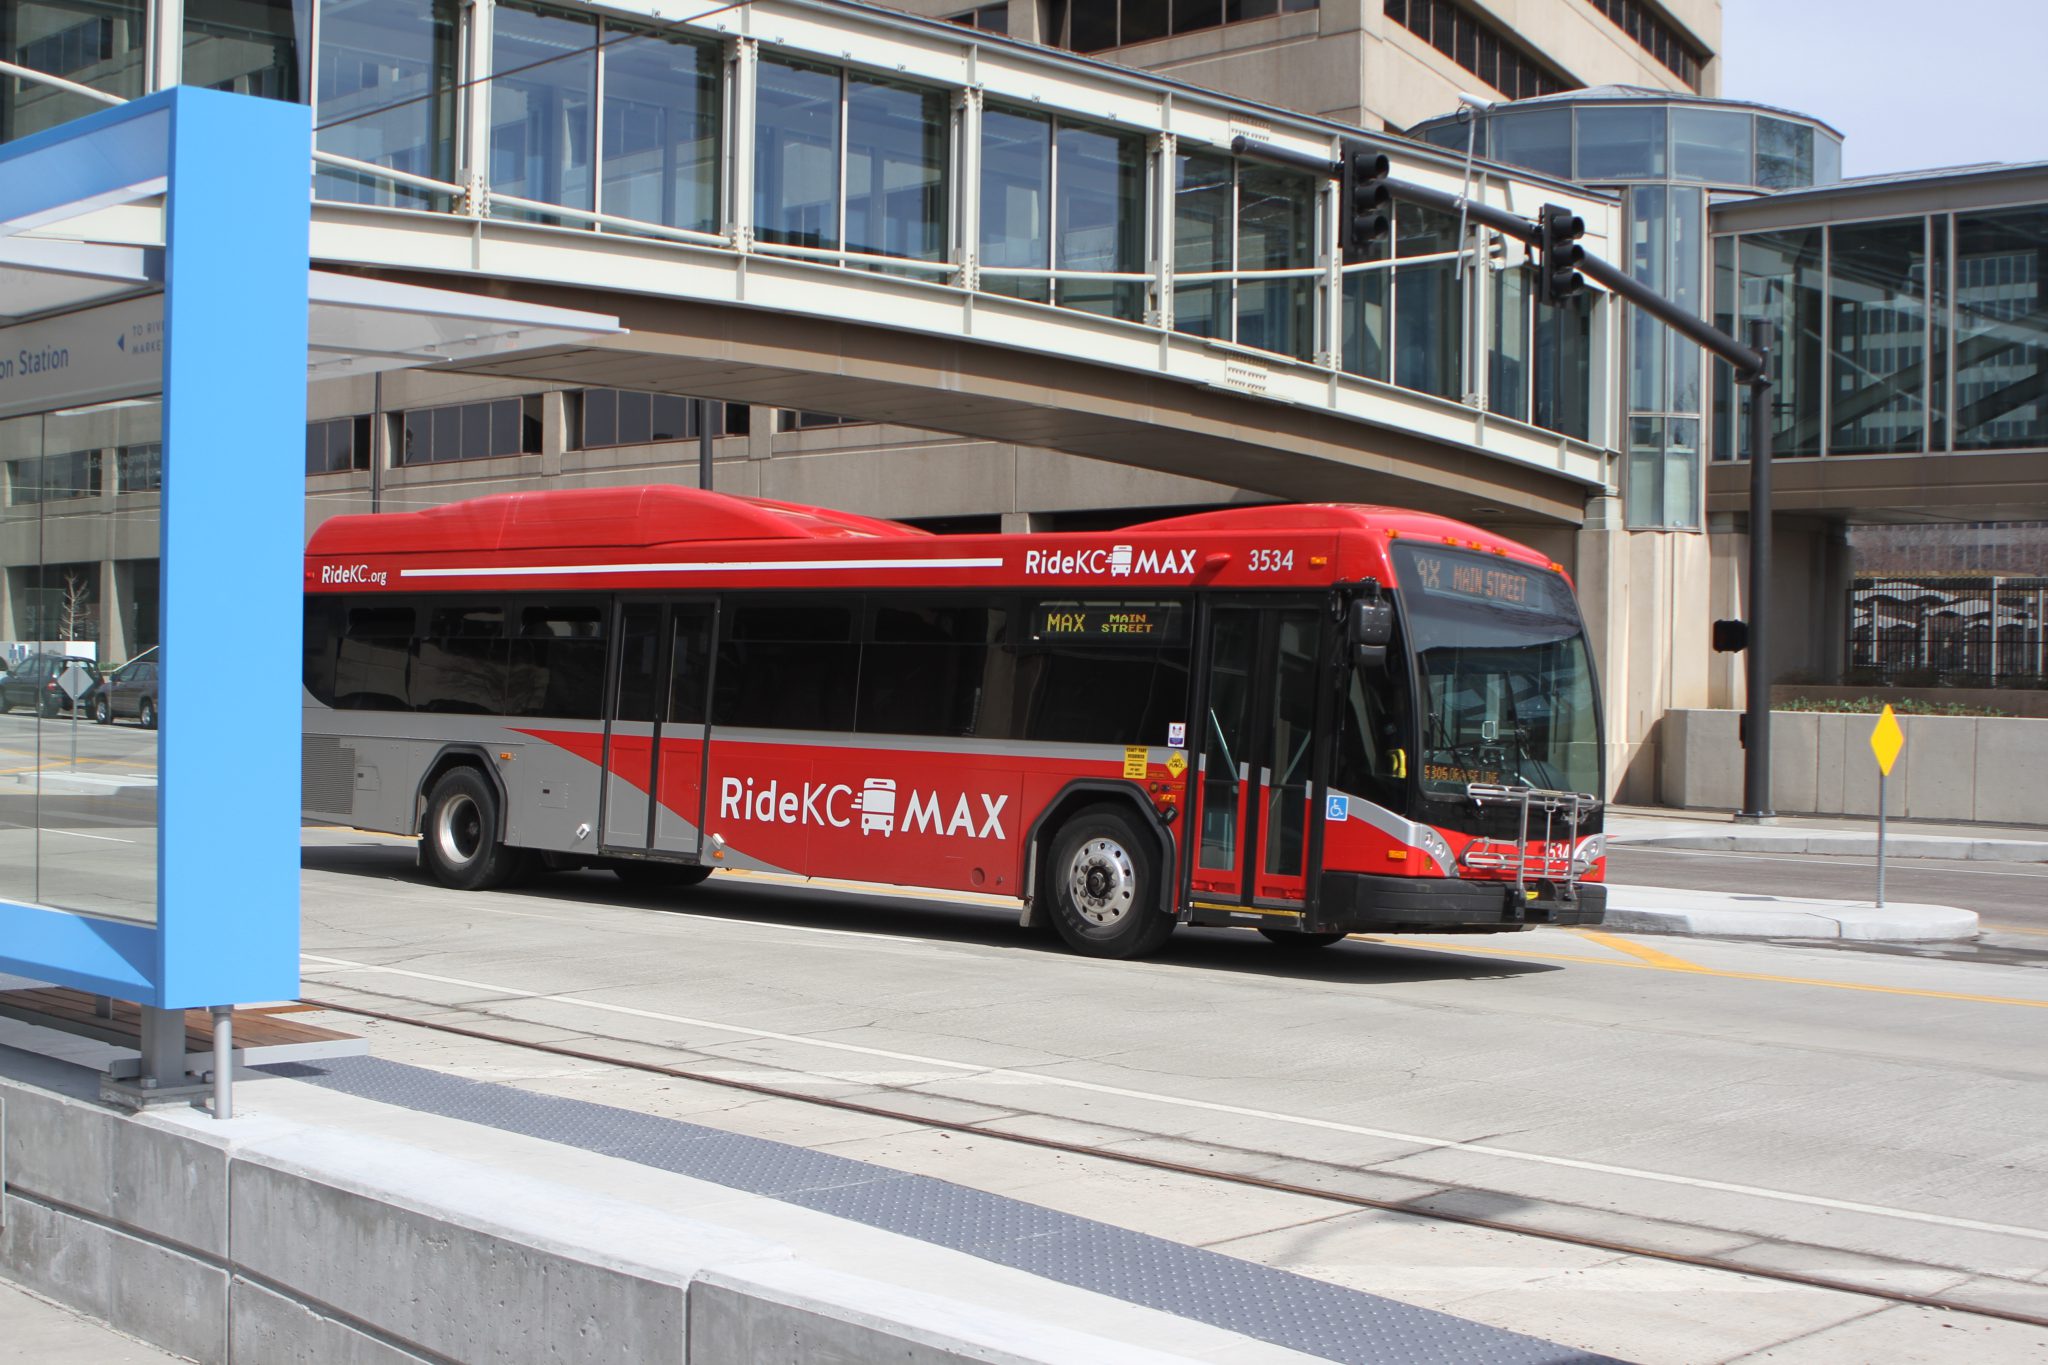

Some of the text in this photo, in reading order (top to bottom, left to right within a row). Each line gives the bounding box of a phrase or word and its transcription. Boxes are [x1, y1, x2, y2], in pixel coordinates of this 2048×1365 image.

[19, 344, 69, 375] Station
[1025, 549, 1197, 574] RideKC MAX
[1248, 549, 1294, 571] 3534
[321, 564, 387, 586] RideKC.org
[1452, 564, 1483, 594] MAIN
[1485, 570, 1528, 602] STREET
[1047, 613, 1086, 632] MAX
[1101, 623, 1153, 633] STREET
[1109, 613, 1146, 623] MAIN
[720, 776, 1008, 840] RideKC MAX
[1544, 842, 1570, 864] 534
